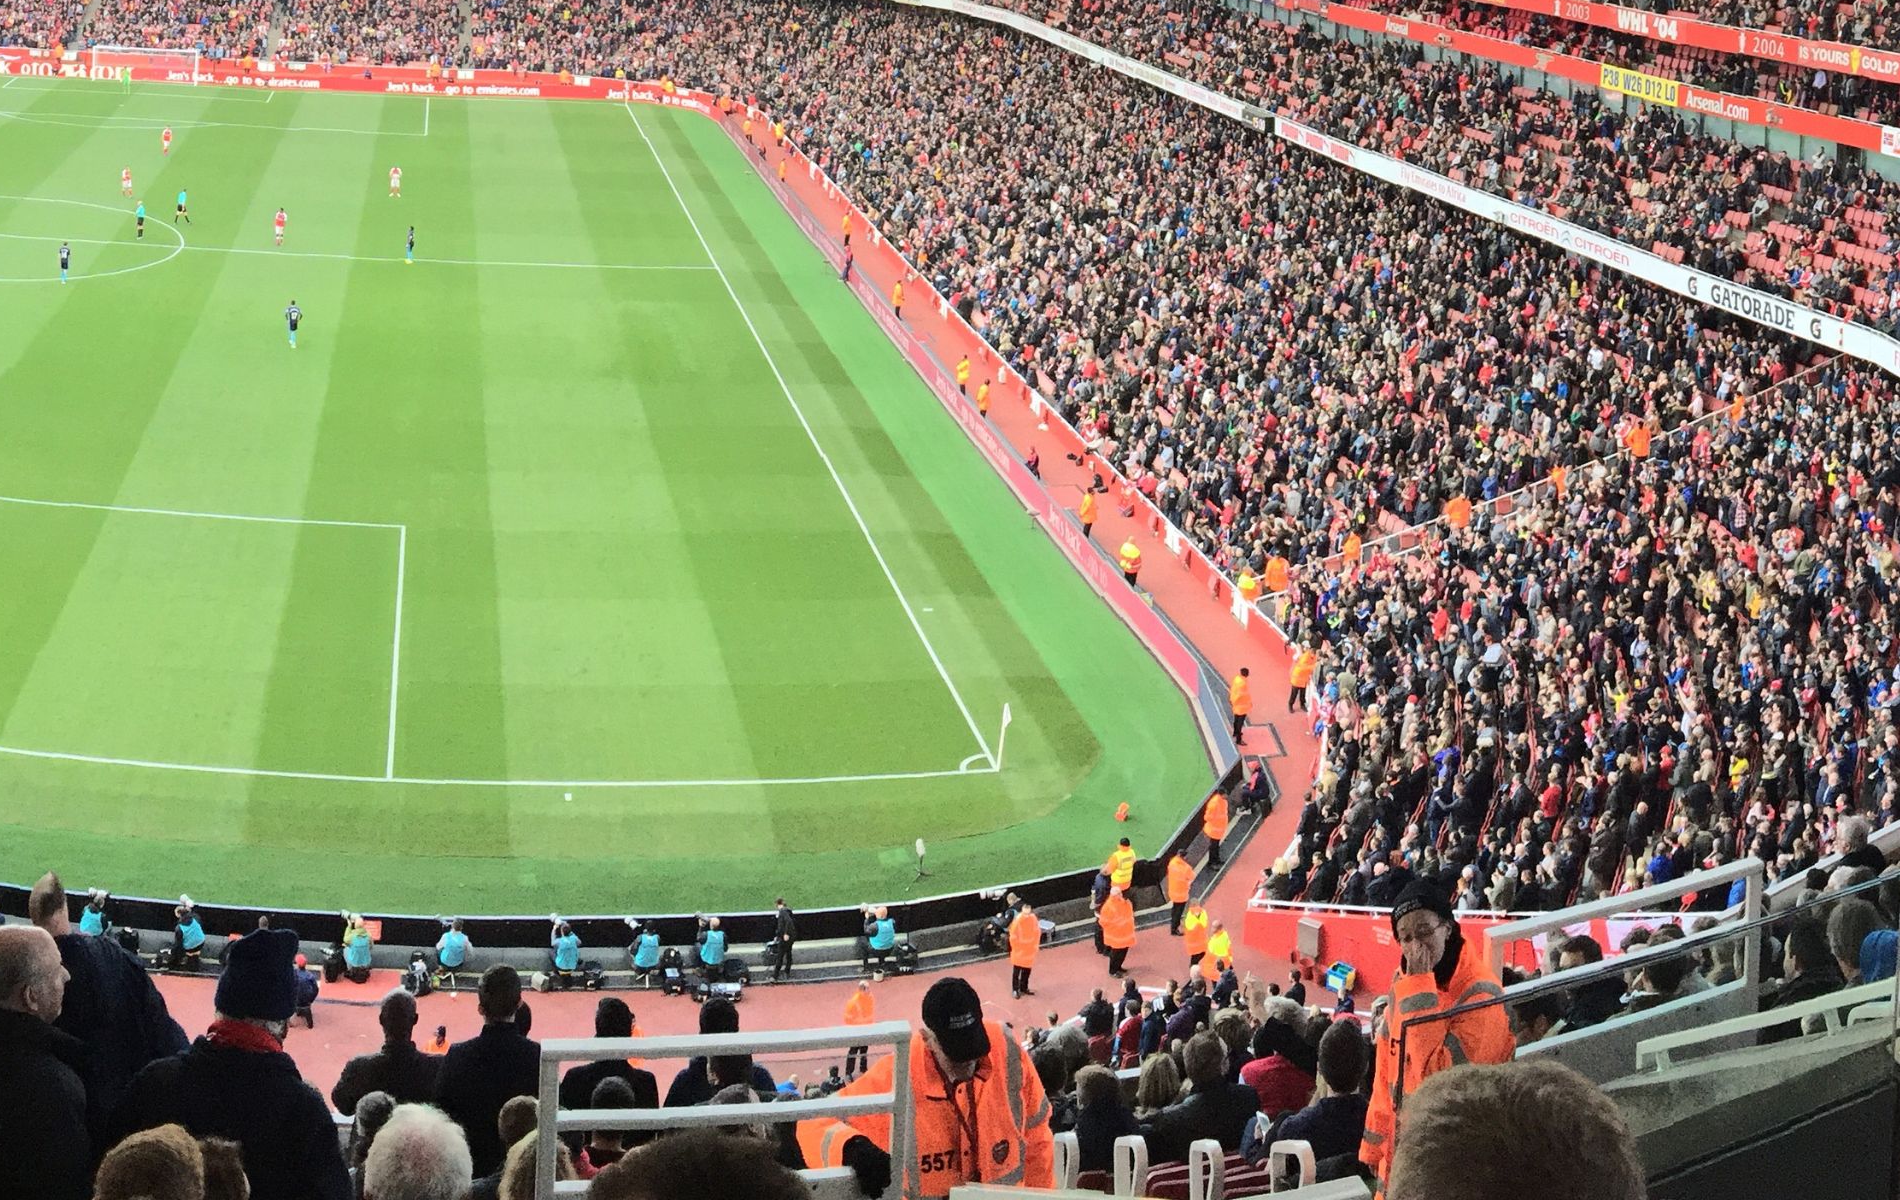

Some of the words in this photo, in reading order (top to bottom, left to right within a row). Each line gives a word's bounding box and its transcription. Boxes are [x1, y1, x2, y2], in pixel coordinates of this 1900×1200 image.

[1565, 2, 1591, 21] 2003
[1617, 10, 1649, 34] WHL
[1753, 39, 1785, 58] 2004
[1811, 49, 1850, 66] YOURS
[1861, 55, 1900, 76] GOLD?
[242, 76, 253, 86] to
[386, 81, 410, 93] Jen's
[462, 85, 474, 95] to
[475, 85, 540, 97] emirates.com
[1602, 67, 1620, 88] P38
[1623, 72, 1642, 94] W26
[1644, 78, 1663, 99] D12
[1685, 93, 1750, 122] Arsenal.com
[1687, 276, 1698, 296] G
[1710, 284, 1795, 331] GATORADE
[1809, 317, 1822, 340] G
[921, 1150, 957, 1174] 557
